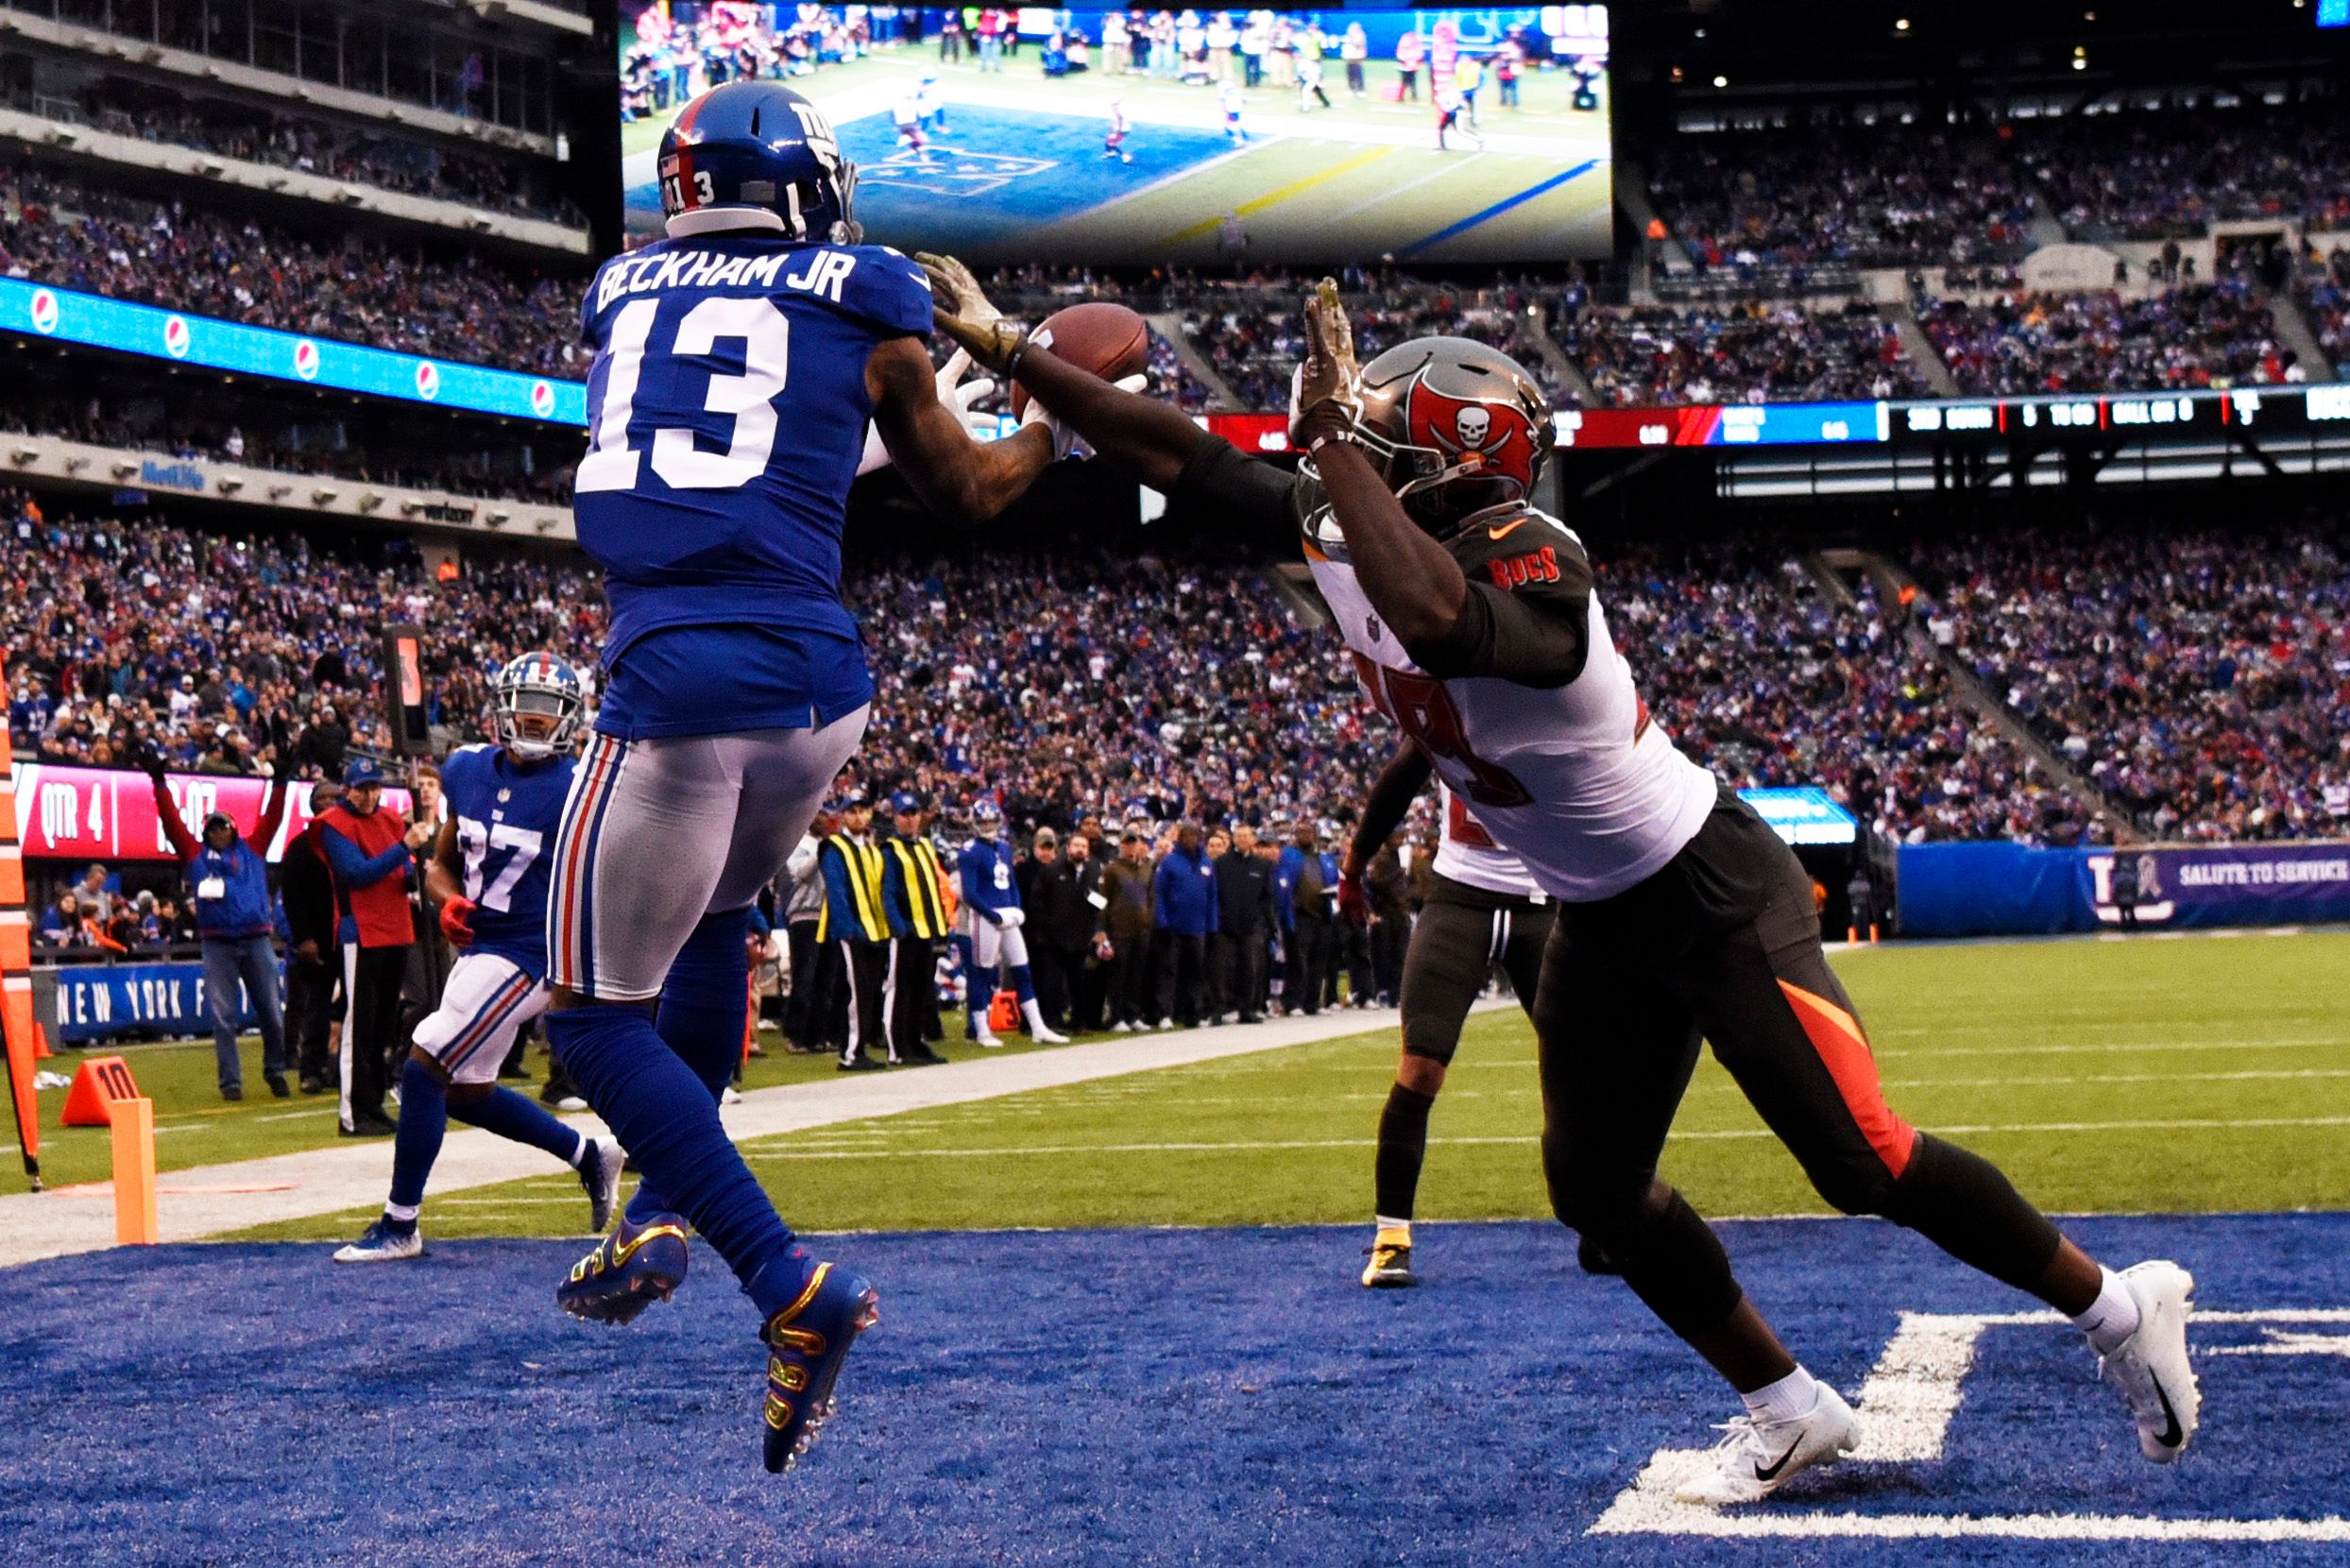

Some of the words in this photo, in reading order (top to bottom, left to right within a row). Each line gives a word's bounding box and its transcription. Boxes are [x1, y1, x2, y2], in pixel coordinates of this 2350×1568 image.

[597, 251, 790, 314] BECKHAM
[786, 250, 857, 303] JR
[574, 298, 790, 493] 13
[1488, 544, 1560, 592] BUCS
[41, 782, 77, 849] QTR
[87, 782, 103, 843] 4
[457, 814, 543, 913] 87
[2179, 863, 2248, 886] SALUTE
[2249, 862, 2273, 884] TO
[2275, 860, 2349, 882] SERVICE
[57, 982, 111, 1025] NEW
[125, 979, 181, 1021] YORK
[97, 1065, 138, 1100] 10
